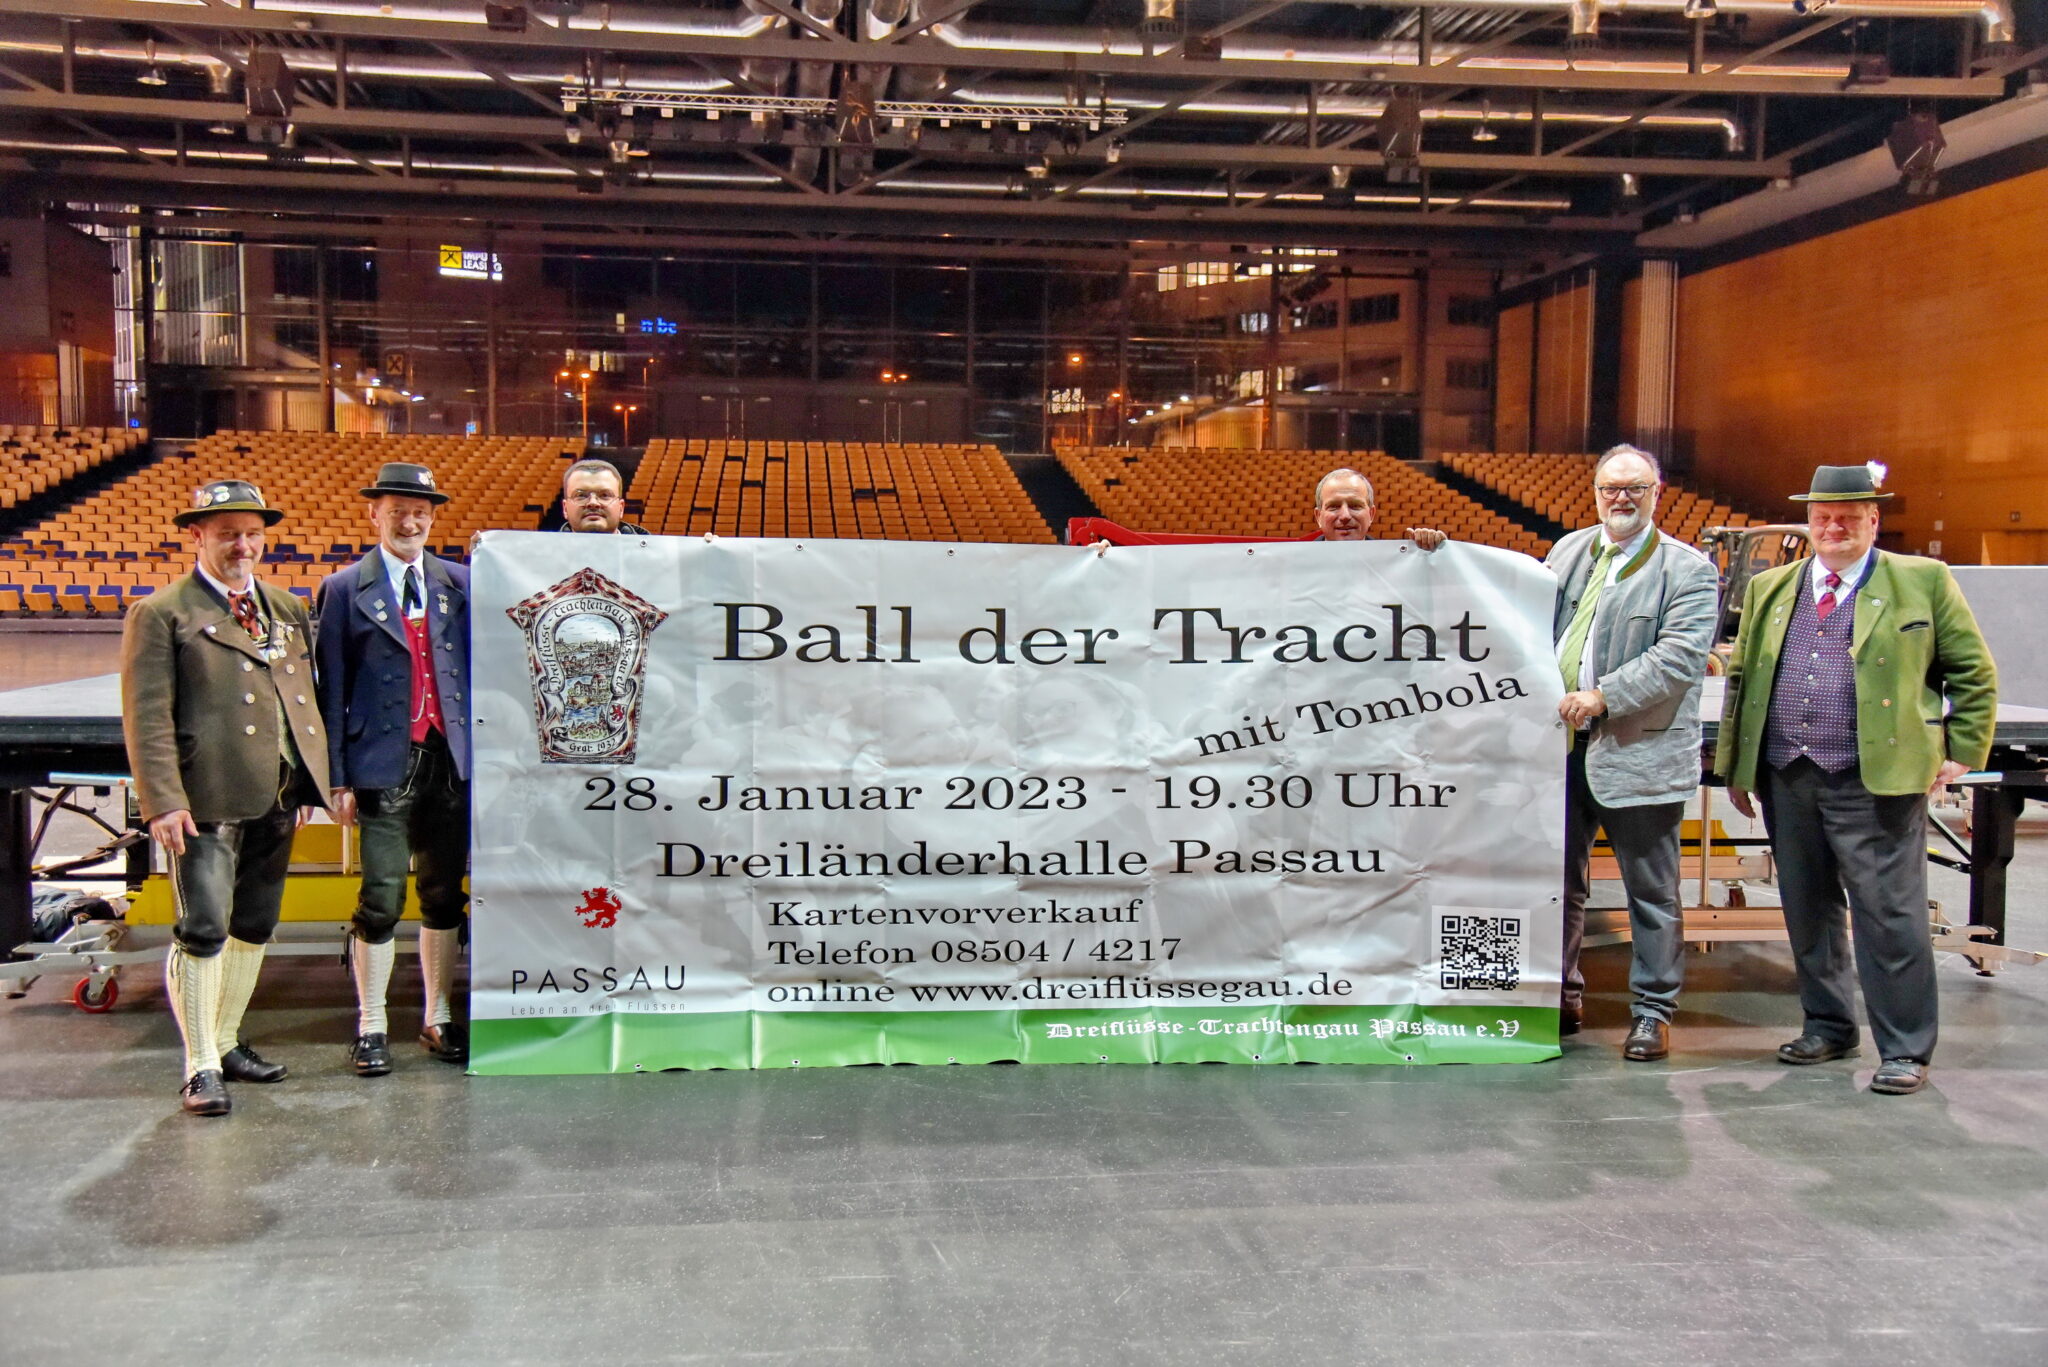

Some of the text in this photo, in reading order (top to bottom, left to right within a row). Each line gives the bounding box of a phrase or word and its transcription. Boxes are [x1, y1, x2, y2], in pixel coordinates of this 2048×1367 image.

[463, 251, 498, 263] IMPUS
[463, 259, 502, 272] LEASIG
[713, 603, 1491, 665] Ball der Tracht
[1194, 671, 1529, 757] mit Tombola
[583, 776, 673, 811] 28.
[697, 775, 923, 812] Januar
[944, 776, 1087, 810] 2023
[1155, 775, 1313, 810] 19.30
[1335, 772, 1457, 808] Uhr
[656, 839, 1386, 878] Dreiländerhalle Passau
[768, 899, 1143, 926] Kartenvorverkauf
[768, 940, 917, 965] Telefon
[931, 939, 1051, 963] 08504
[1088, 937, 1182, 961] 4217
[512, 965, 685, 995] PASSAU
[767, 972, 1353, 1003] online www.dreiflüssegau.de
[511, 1004, 554, 1016] Leben
[562, 1006, 578, 1014] an
[1368, 1018, 1467, 1039] Passau
